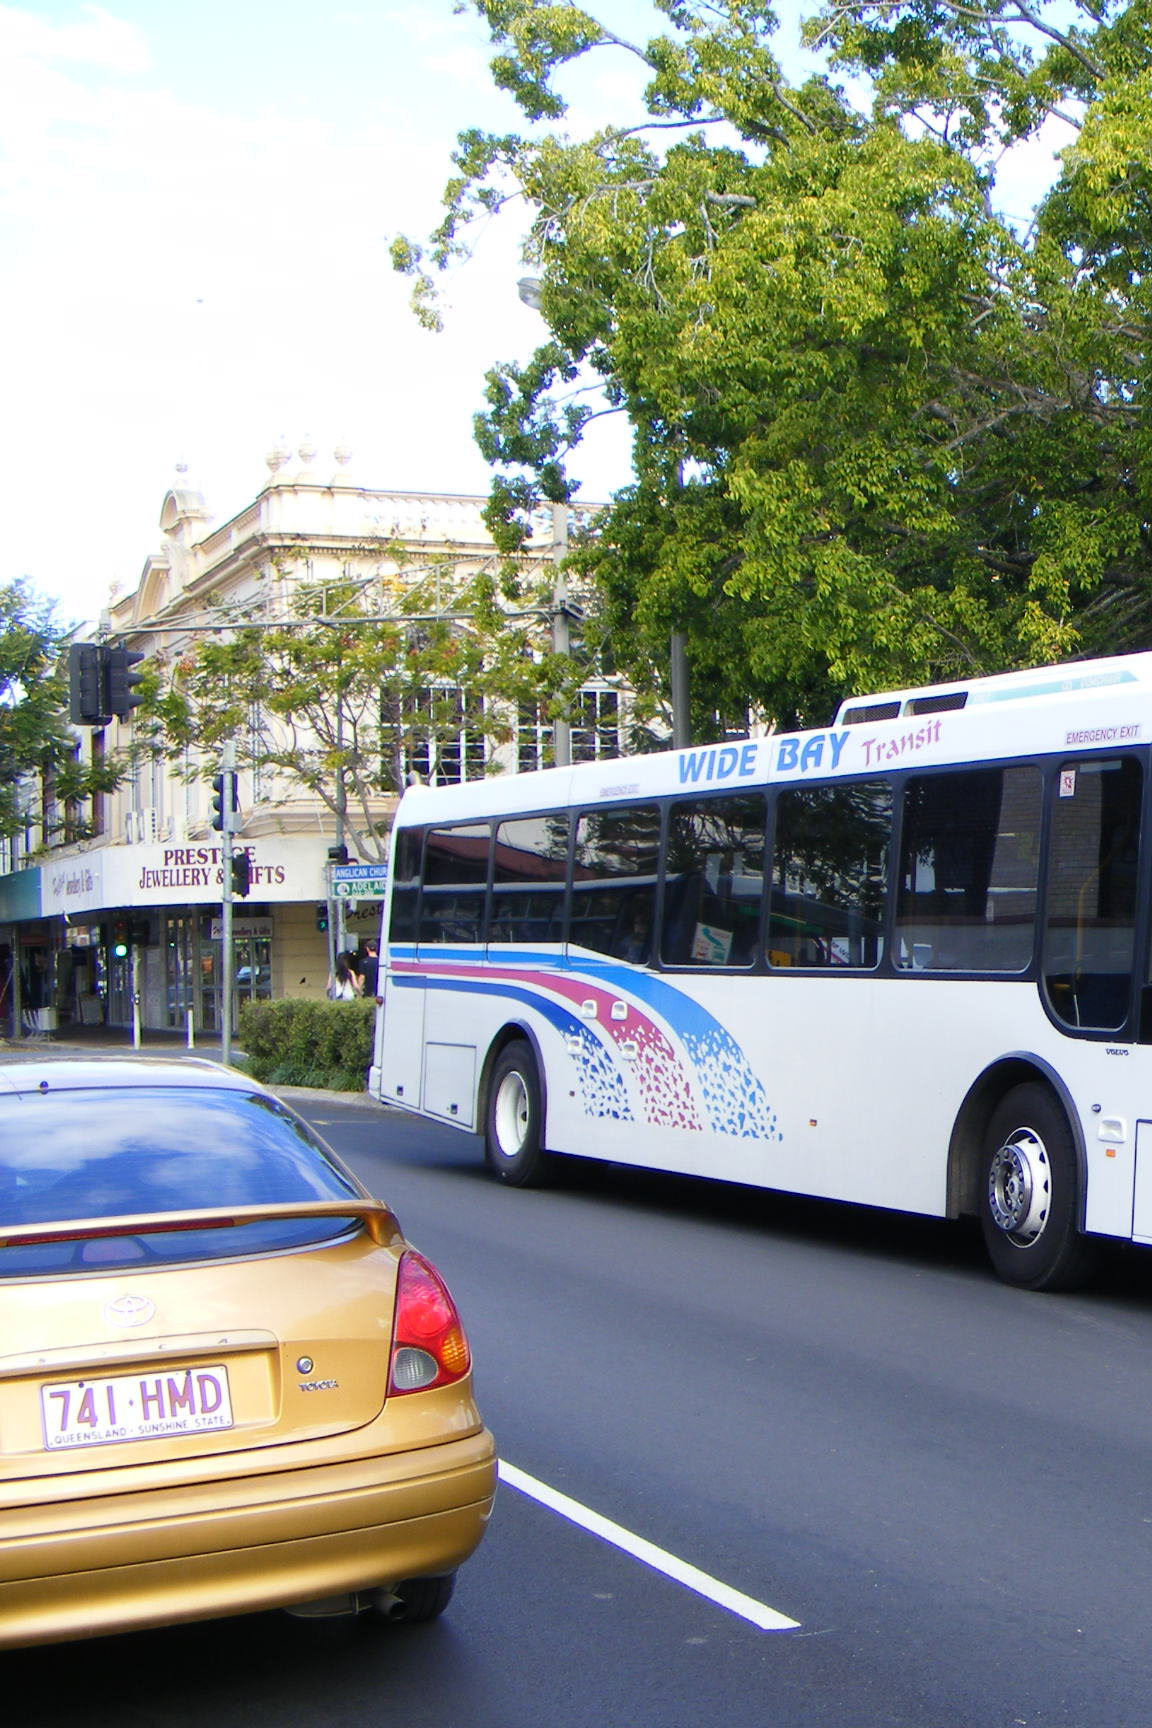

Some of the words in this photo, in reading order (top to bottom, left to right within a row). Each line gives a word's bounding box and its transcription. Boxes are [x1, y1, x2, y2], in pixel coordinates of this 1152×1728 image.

[1066, 728, 1118, 744] EMERGENCY
[1119, 725, 1140, 738] EXIT
[679, 744, 757, 784] WIDE
[776, 731, 852, 772] BAY
[862, 719, 943, 767] Transit
[139, 867, 211, 889] JEWELLERY
[337, 868, 368, 878] ANGLICAN
[299, 1379, 338, 1391] TOYOTA
[54, 1427, 126, 1444] QUEENSLAND
[138, 1419, 188, 1435] SUNSHINE
[194, 1415, 225, 1428] STATE
